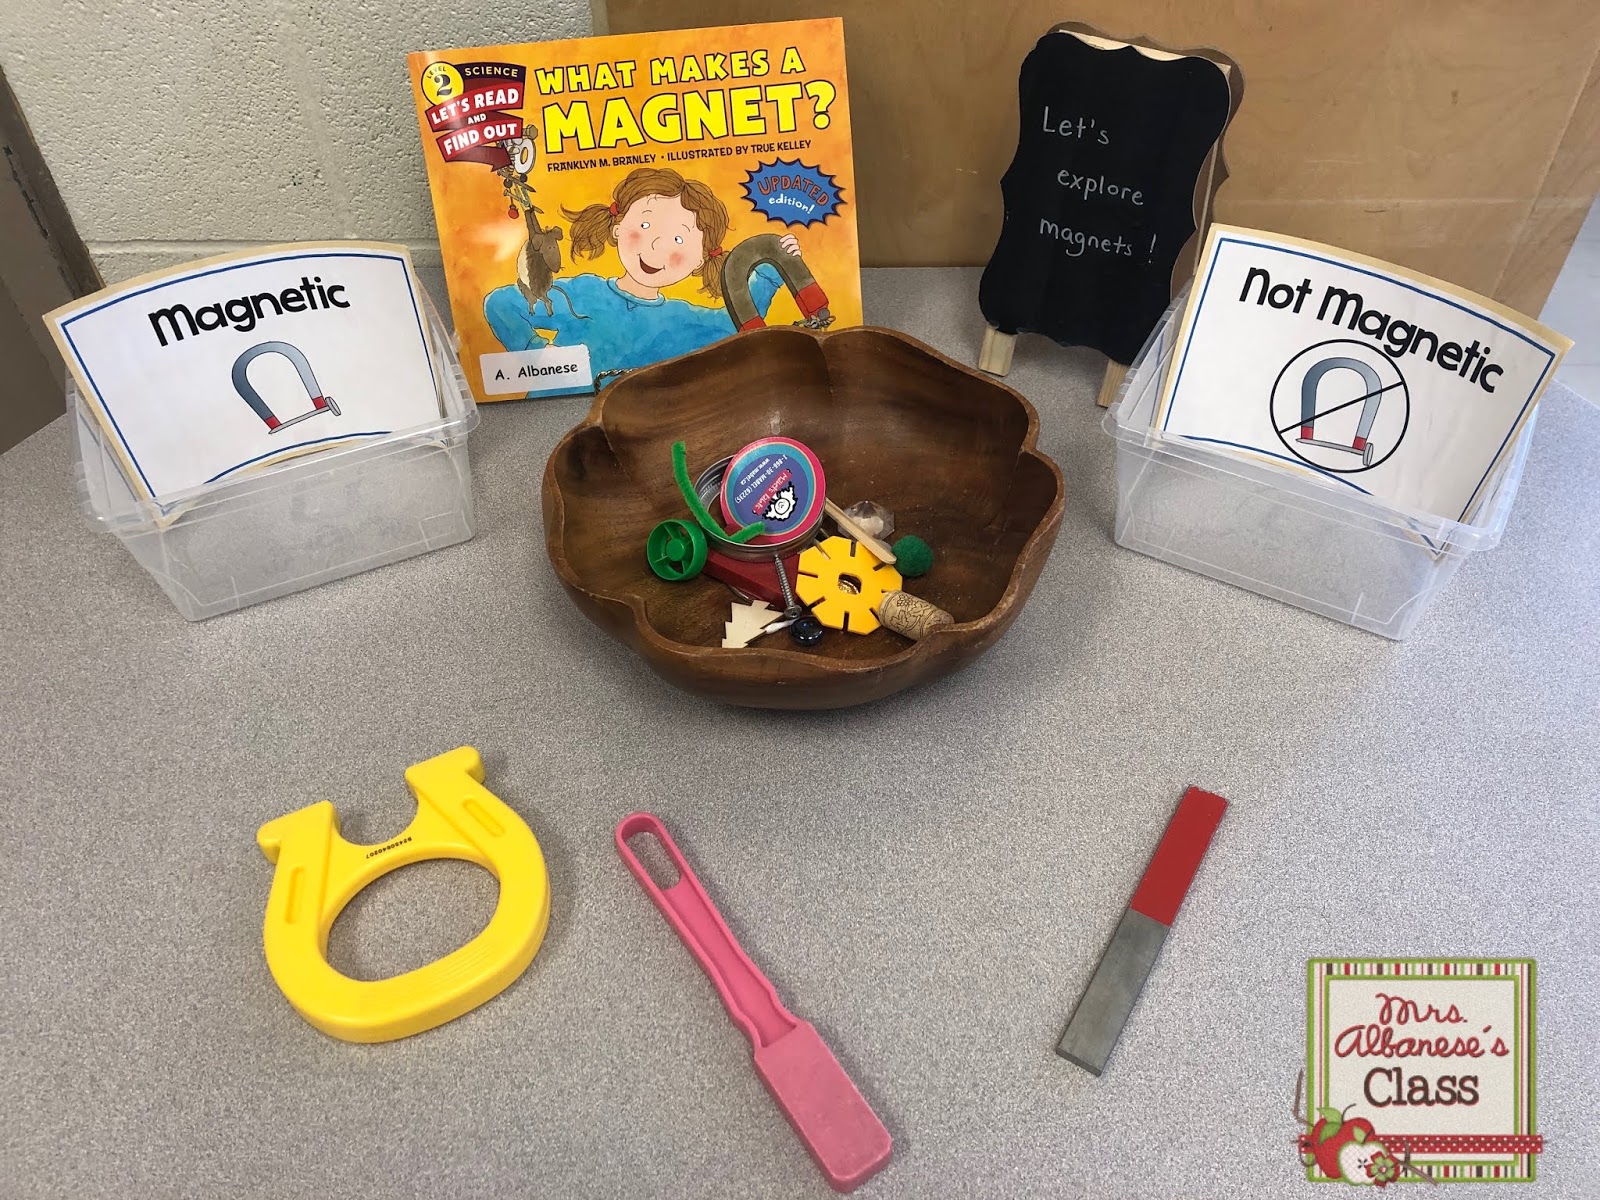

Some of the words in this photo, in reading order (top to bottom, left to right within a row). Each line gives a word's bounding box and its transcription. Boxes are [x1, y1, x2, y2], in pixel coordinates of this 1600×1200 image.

[427, 66, 447, 79] LEVEL
[434, 74, 452, 96] 2
[464, 66, 518, 77] SCIENCE
[535, 60, 637, 95] WHAT
[651, 49, 769, 88] MAKES
[782, 47, 806, 74] A
[431, 98, 470, 124] LET'S
[474, 88, 519, 109] READ
[467, 113, 486, 125] AND
[542, 80, 836, 154] MAGNET?
[443, 129, 480, 156] FIND
[483, 123, 518, 139] OUT
[1042, 105, 1110, 145] Let's
[547, 160, 597, 172] FRANKLYN
[599, 158, 611, 167] M.
[613, 154, 656, 166] BRANLEY
[667, 147, 733, 161] ILLUSTRATED
[736, 145, 749, 155] BY
[751, 143, 775, 154] TRUE
[777, 140, 812, 151] KELLEY
[757, 175, 830, 206] UPDATED
[1057, 169, 1144, 206] explore
[768, 193, 815, 214] edition!
[495, 369, 510, 380] A.
[518, 363, 579, 378] Albanese
